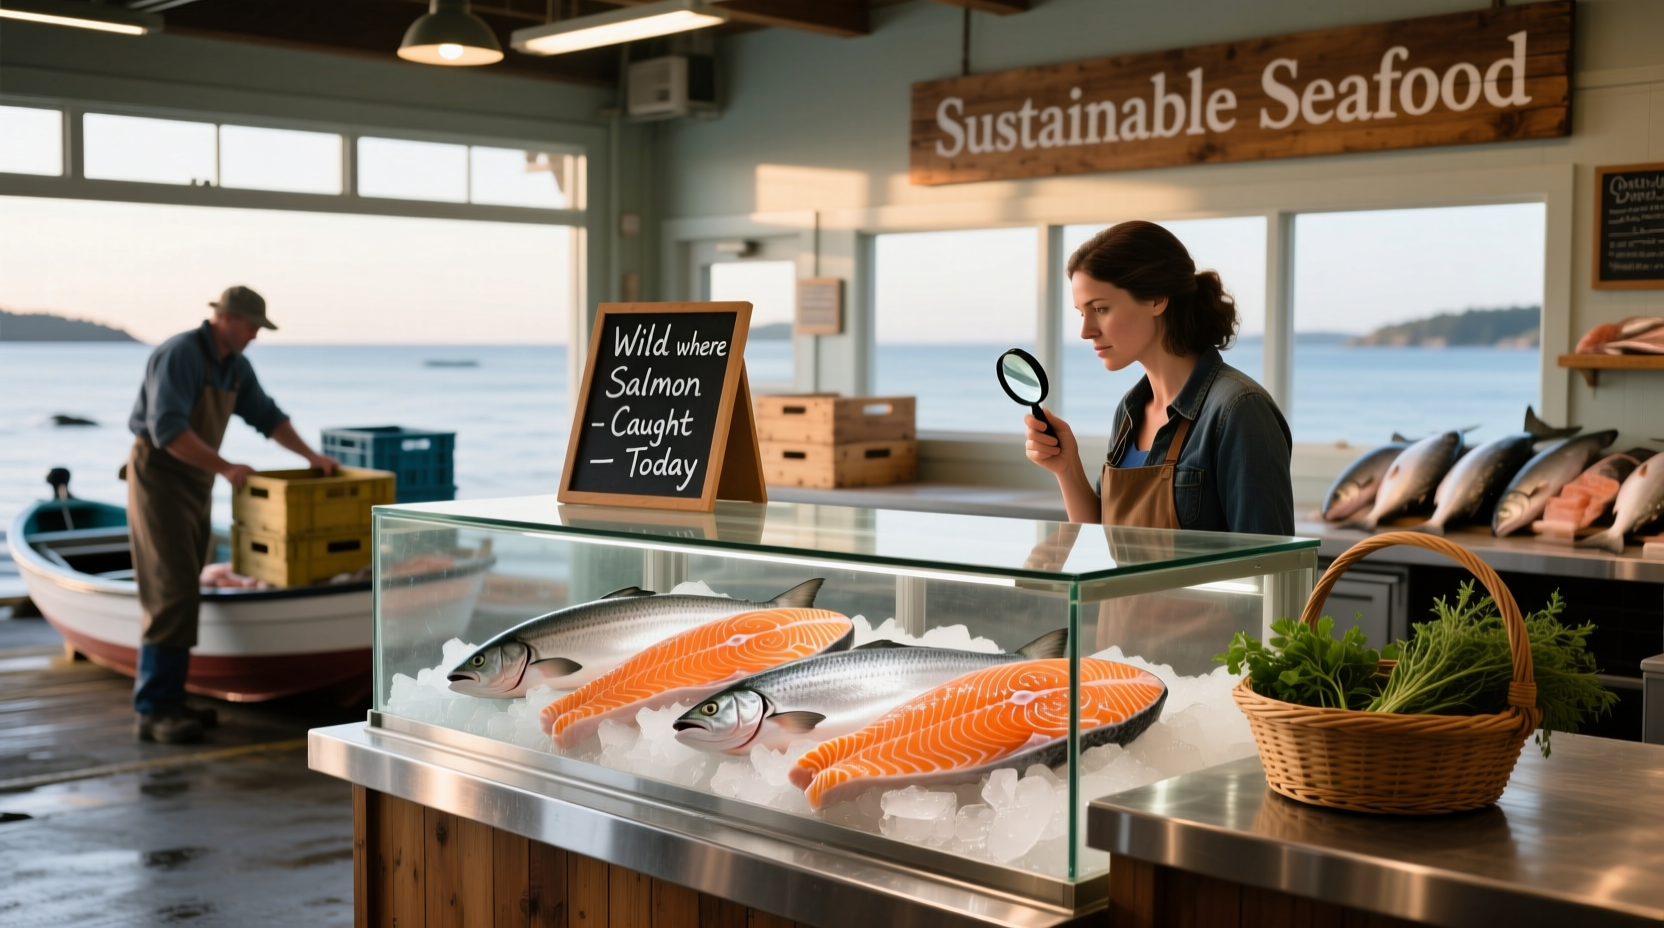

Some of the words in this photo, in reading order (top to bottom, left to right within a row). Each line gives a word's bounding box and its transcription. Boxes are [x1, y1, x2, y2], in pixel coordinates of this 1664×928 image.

[935, 66, 1237, 158] Sustainable
[1259, 30, 1532, 130] Seafood
[614, 323, 672, 357] Wild
[676, 330, 727, 357] where
[605, 365, 701, 398] Salmon
[611, 405, 694, 447] Caught
[626, 446, 698, 491] Today
